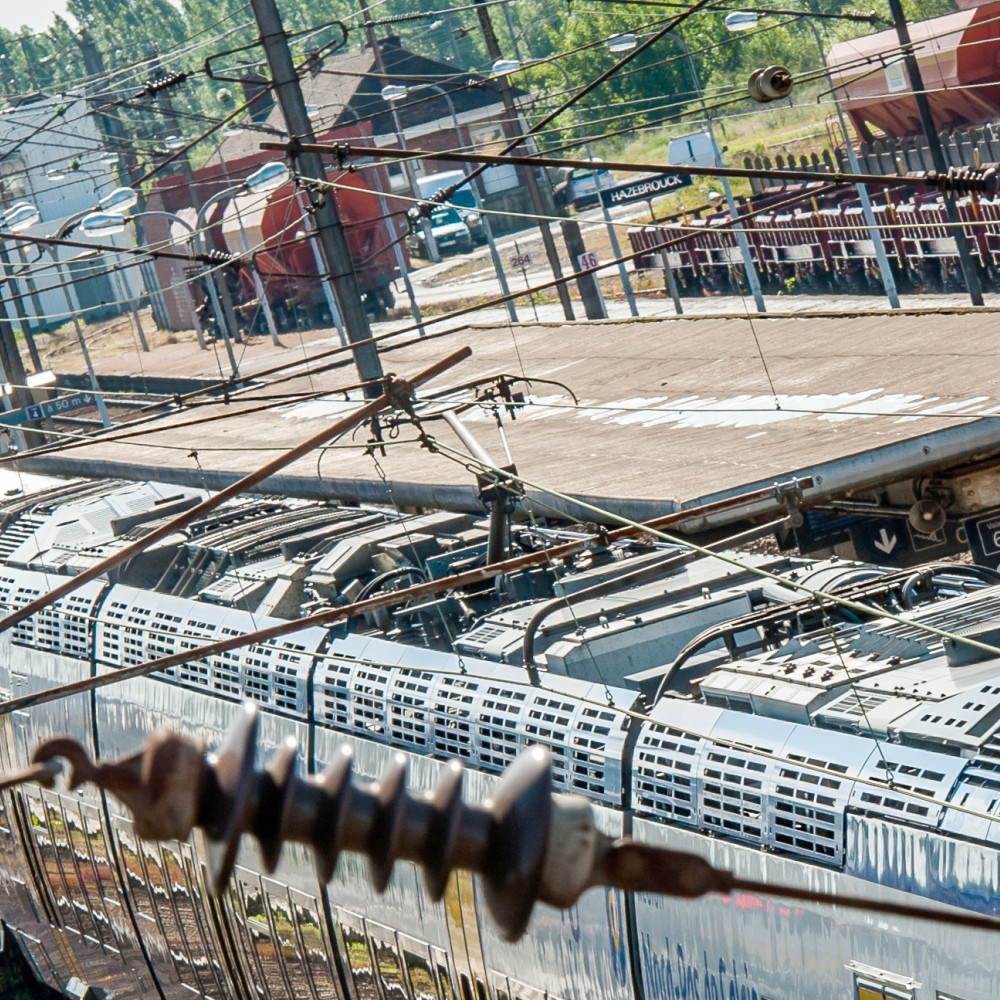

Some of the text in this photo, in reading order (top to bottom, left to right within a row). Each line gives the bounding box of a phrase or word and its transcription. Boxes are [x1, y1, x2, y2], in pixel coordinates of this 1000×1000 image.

[611, 174, 682, 202] HAZEBROUCK
[581, 253, 598, 270] 46
[55, 401, 69, 410] 50
[71, 398, 81, 406] m
